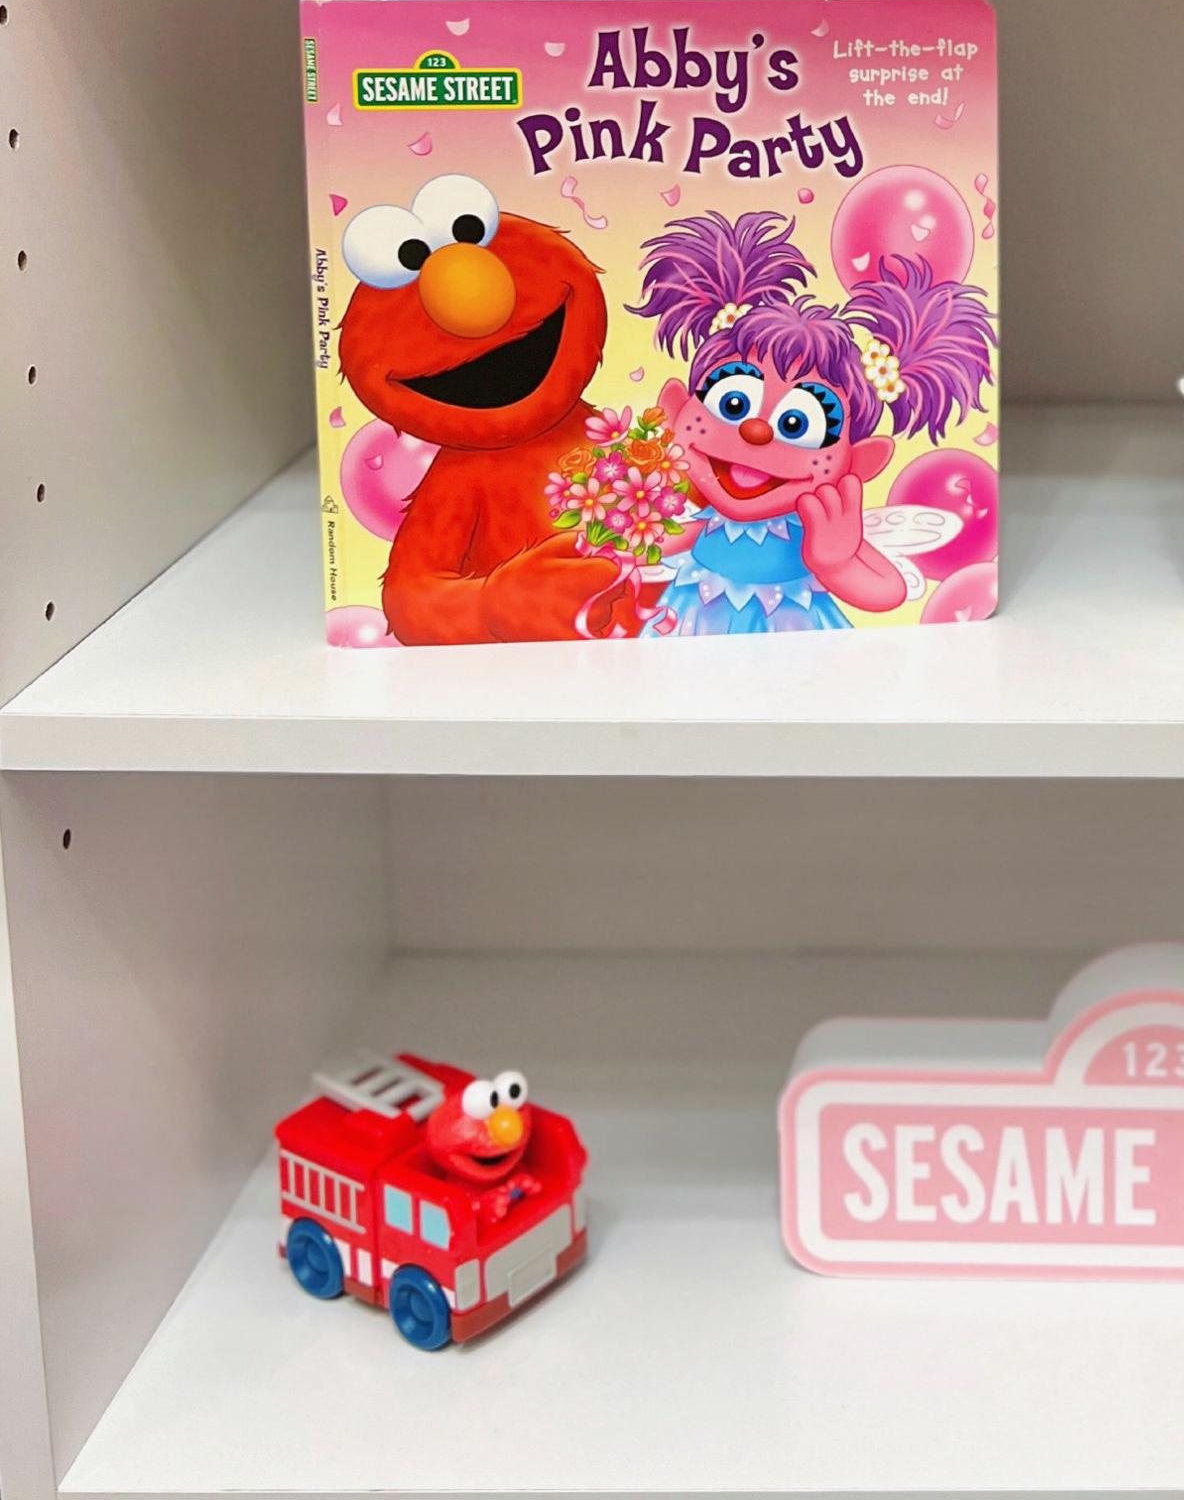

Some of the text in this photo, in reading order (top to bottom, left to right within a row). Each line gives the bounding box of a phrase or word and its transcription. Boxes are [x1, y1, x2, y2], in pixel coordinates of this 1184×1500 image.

[427, 57, 447, 67] 123
[587, 27, 799, 113] Abby's
[832, 38, 979, 61] Lift-the-flap
[849, 63, 965, 86] surprise at
[361, 75, 513, 102] SESAME STREET
[863, 87, 949, 107] the end!
[517, 100, 864, 178] Pink Party
[313, 248, 331, 369] Abby's Pink Party
[327, 521, 339, 601] Random House
[842, 1122, 1157, 1226] SESAME
